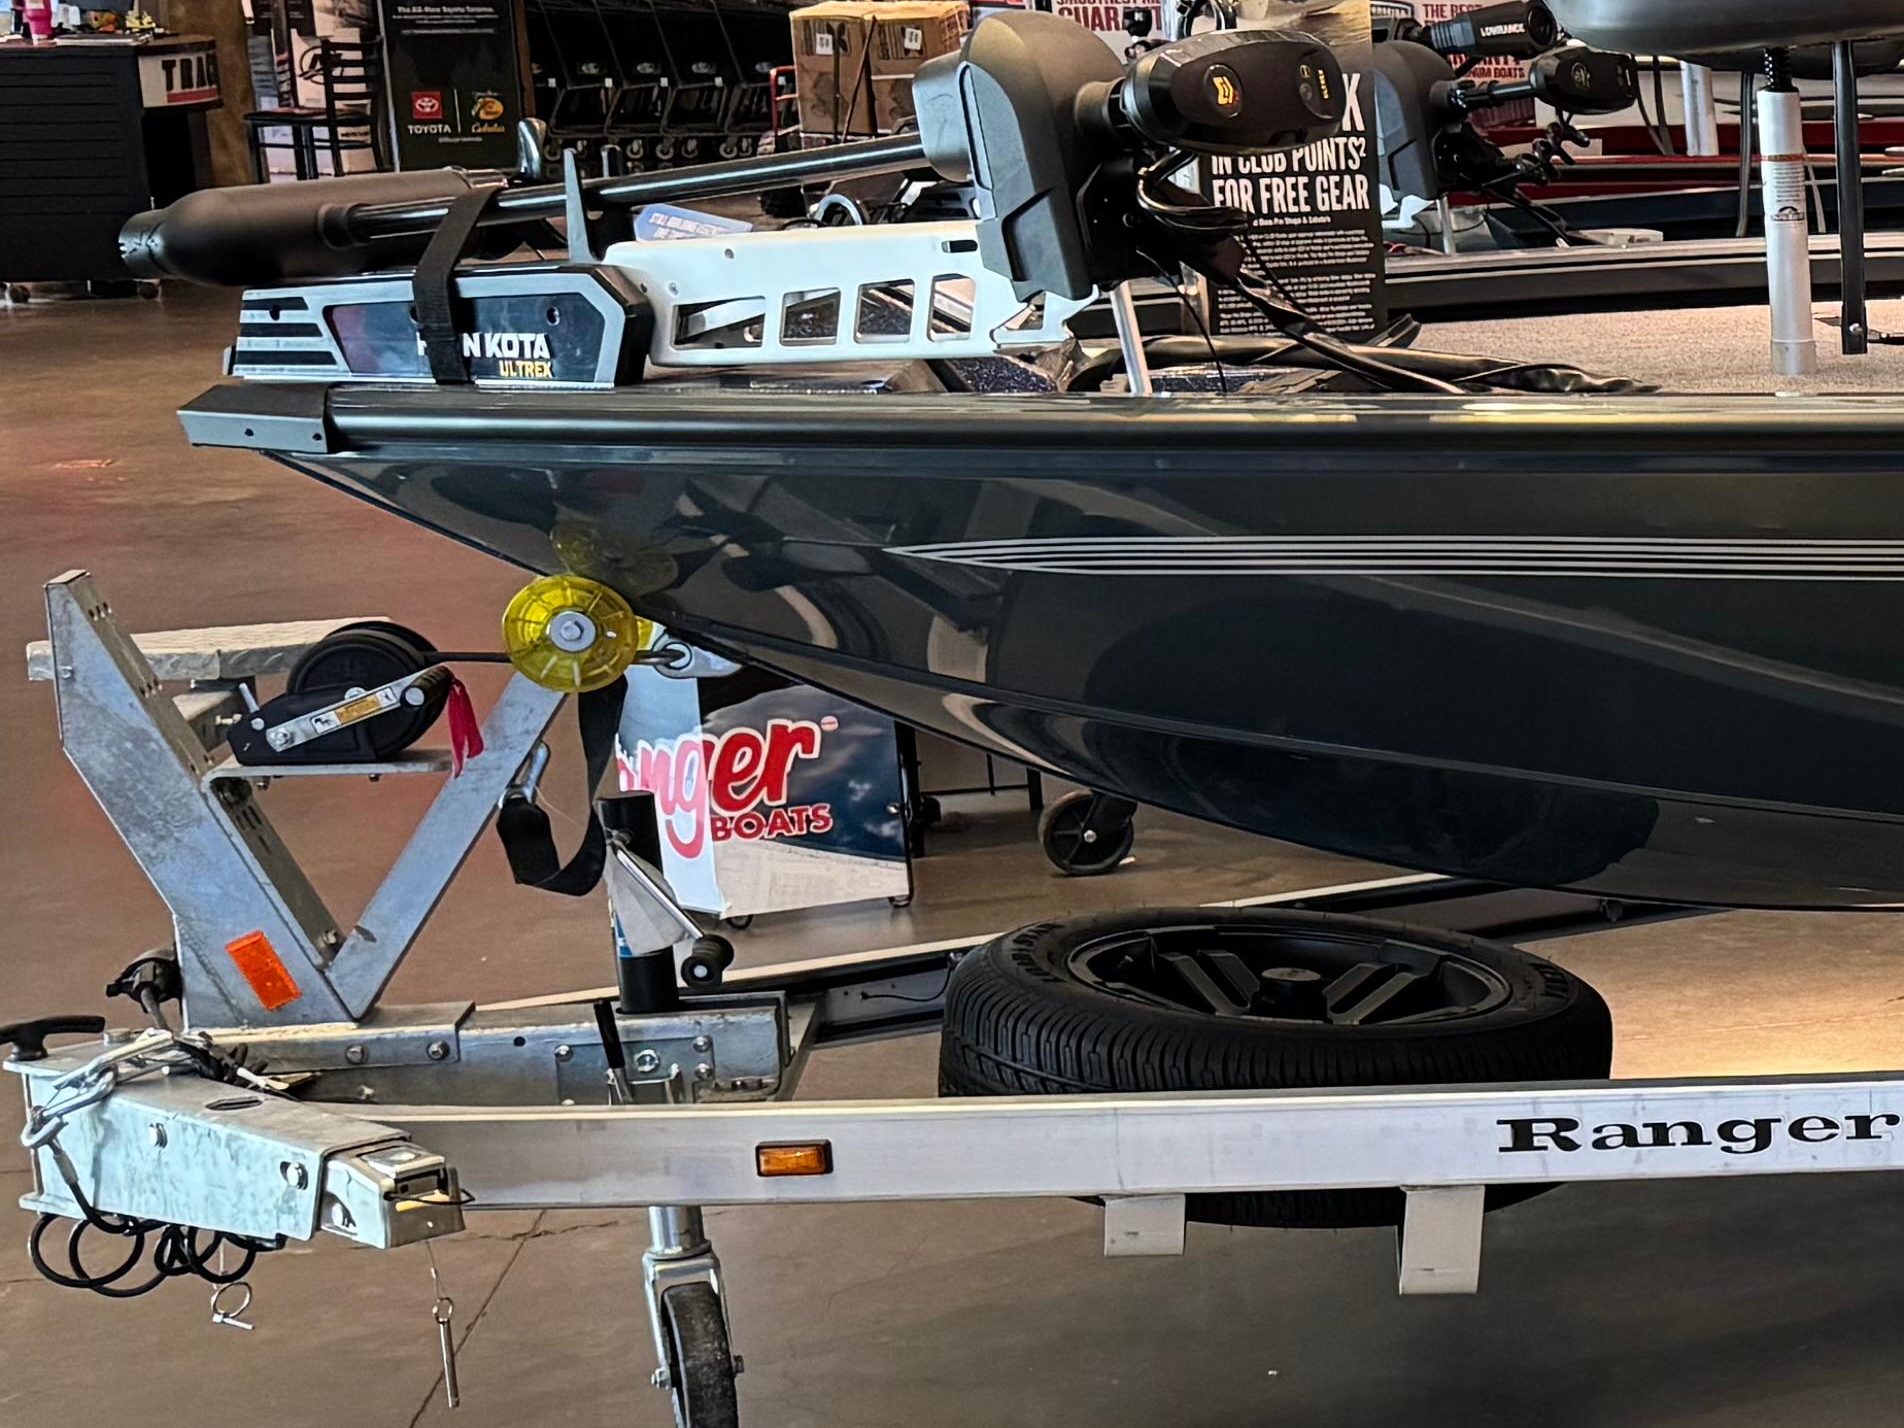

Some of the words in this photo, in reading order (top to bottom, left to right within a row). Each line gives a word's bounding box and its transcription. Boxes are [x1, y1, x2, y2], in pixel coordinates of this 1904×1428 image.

[1422, 4, 1448, 19] THE
[407, 124, 452, 135] TOYOTA
[1212, 178, 1256, 214] FOR
[1259, 176, 1312, 214] FREE
[1316, 174, 1370, 212] GEAR
[484, 332, 550, 360] KOTA
[499, 359, 554, 380] ULTREX
[711, 803, 834, 843] BOATS
[1496, 1104, 1904, 1157] Ranger
